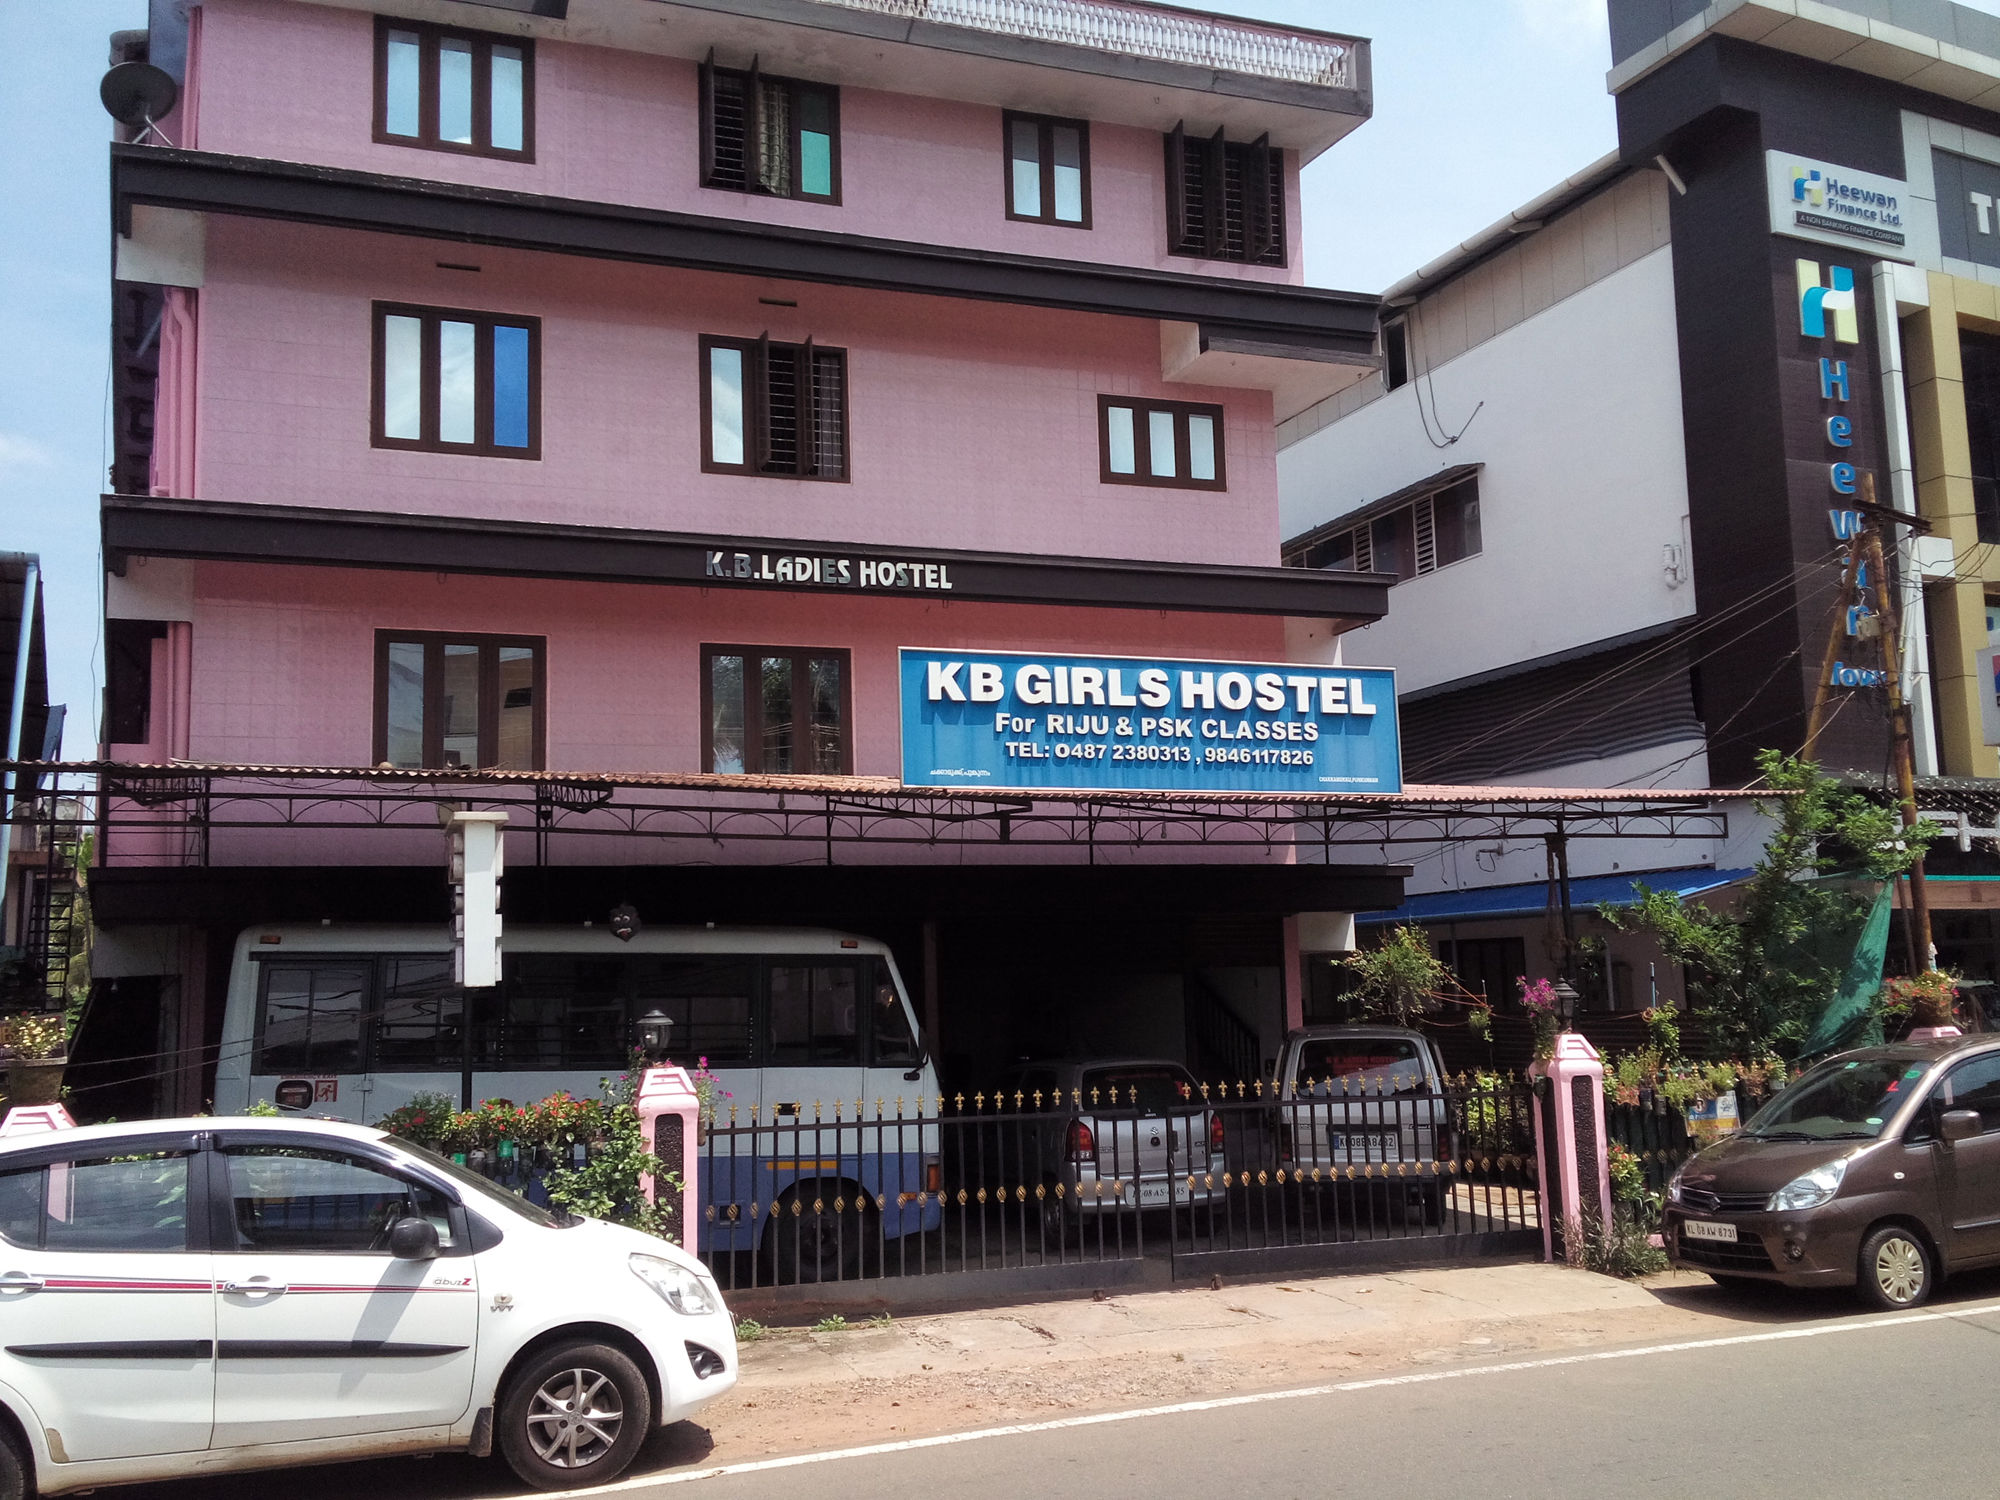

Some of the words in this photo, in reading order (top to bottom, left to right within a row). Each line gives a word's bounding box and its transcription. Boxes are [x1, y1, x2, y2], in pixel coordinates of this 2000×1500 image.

[1826, 177, 1898, 210] Heewan
[1827, 198, 1877, 221] Finance
[1880, 210, 1903, 226] Ltd.
[1970, 192, 2000, 235] T
[860, 560, 952, 589] HOSTEL
[926, 662, 1005, 702] KB
[1016, 665, 1171, 708] GIRLS
[1180, 671, 1377, 715] HOSTEL
[995, 713, 1036, 733] For
[1047, 714, 1109, 735] RIJU
[1115, 716, 1134, 736] &
[1141, 717, 1193, 737] PSK
[1201, 719, 1319, 741] CLASSES
[1005, 741, 1050, 758] TEL:
[1205, 748, 1314, 765] 9846117826
[1686, 1224, 1695, 1234] KL
[1718, 1227, 1736, 1239] 8731
